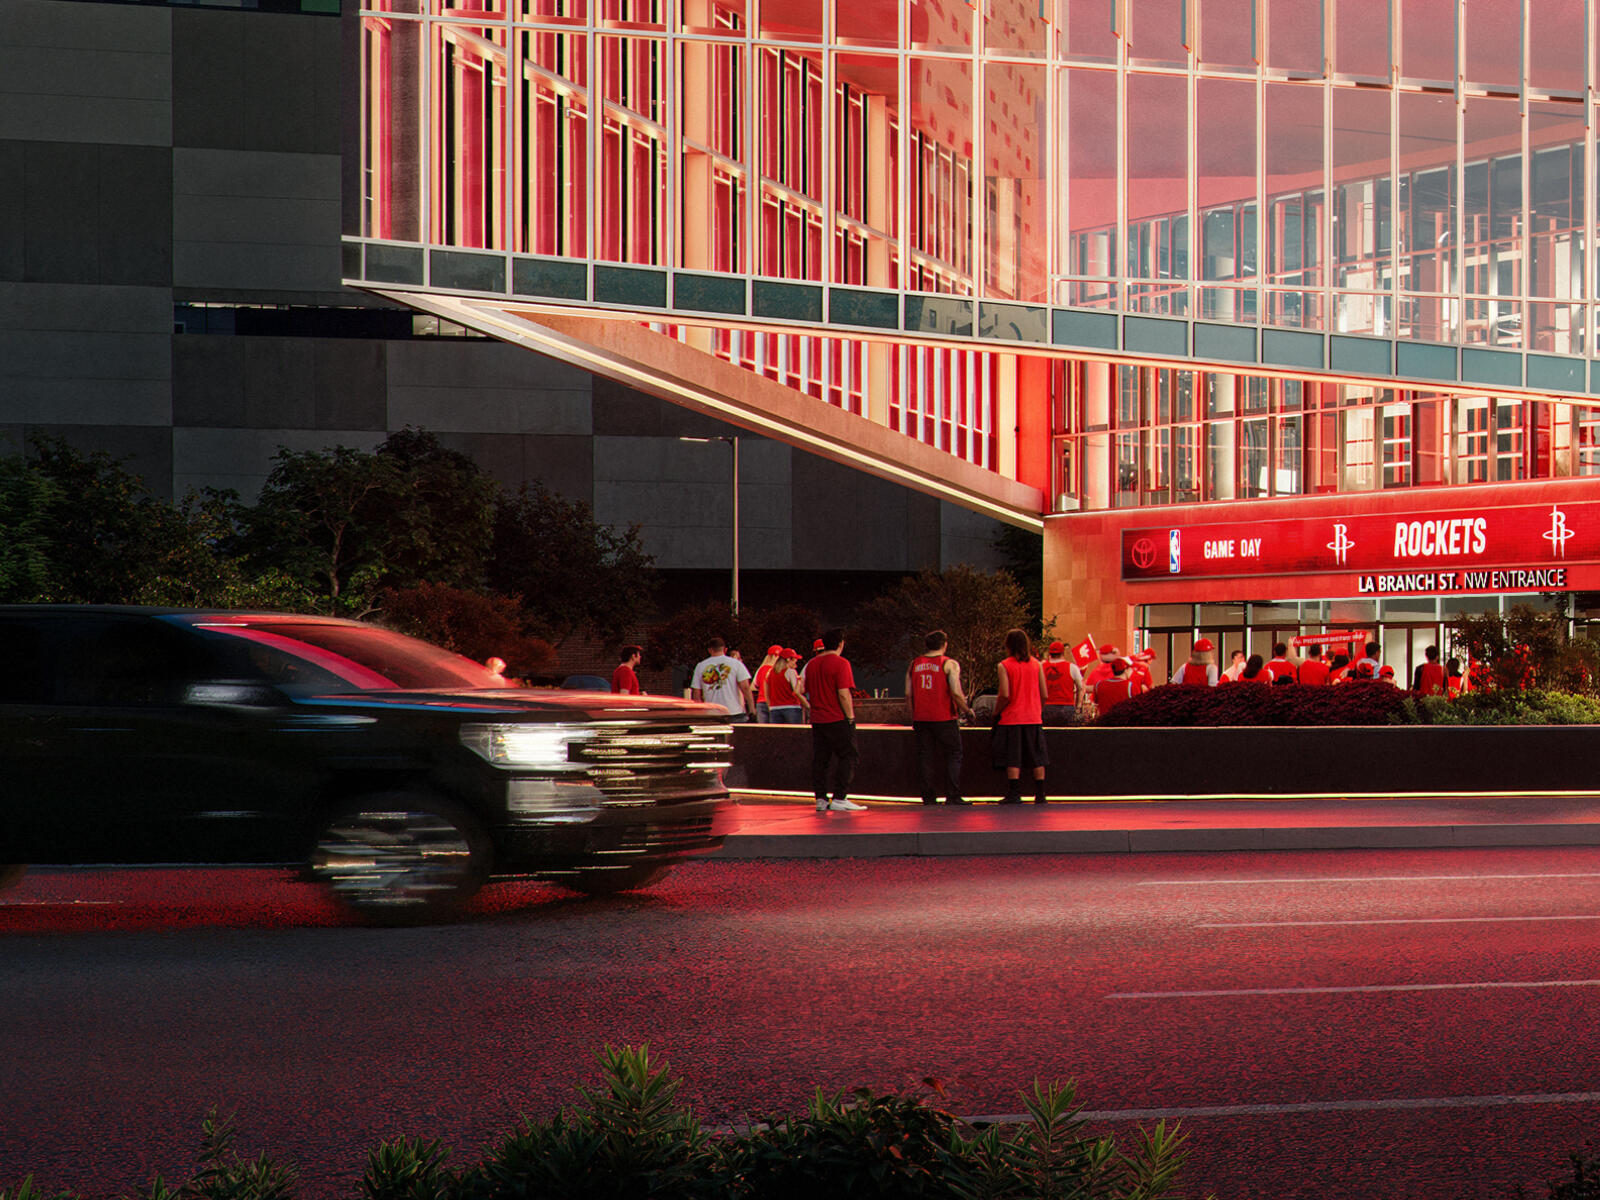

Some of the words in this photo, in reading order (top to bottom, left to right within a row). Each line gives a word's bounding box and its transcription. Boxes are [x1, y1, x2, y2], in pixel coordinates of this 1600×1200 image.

[1203, 540, 1235, 559] GAME
[1240, 538, 1262, 557] DAY
[1393, 517, 1487, 558] ROCKETS
[1358, 576, 1375, 593] LA
[1378, 573, 1435, 592] BRANCH
[1439, 572, 1461, 590] ST.
[1464, 571, 1488, 589] NW
[1491, 568, 1566, 588] ENTRANCE
[920, 674, 933, 690] 13
